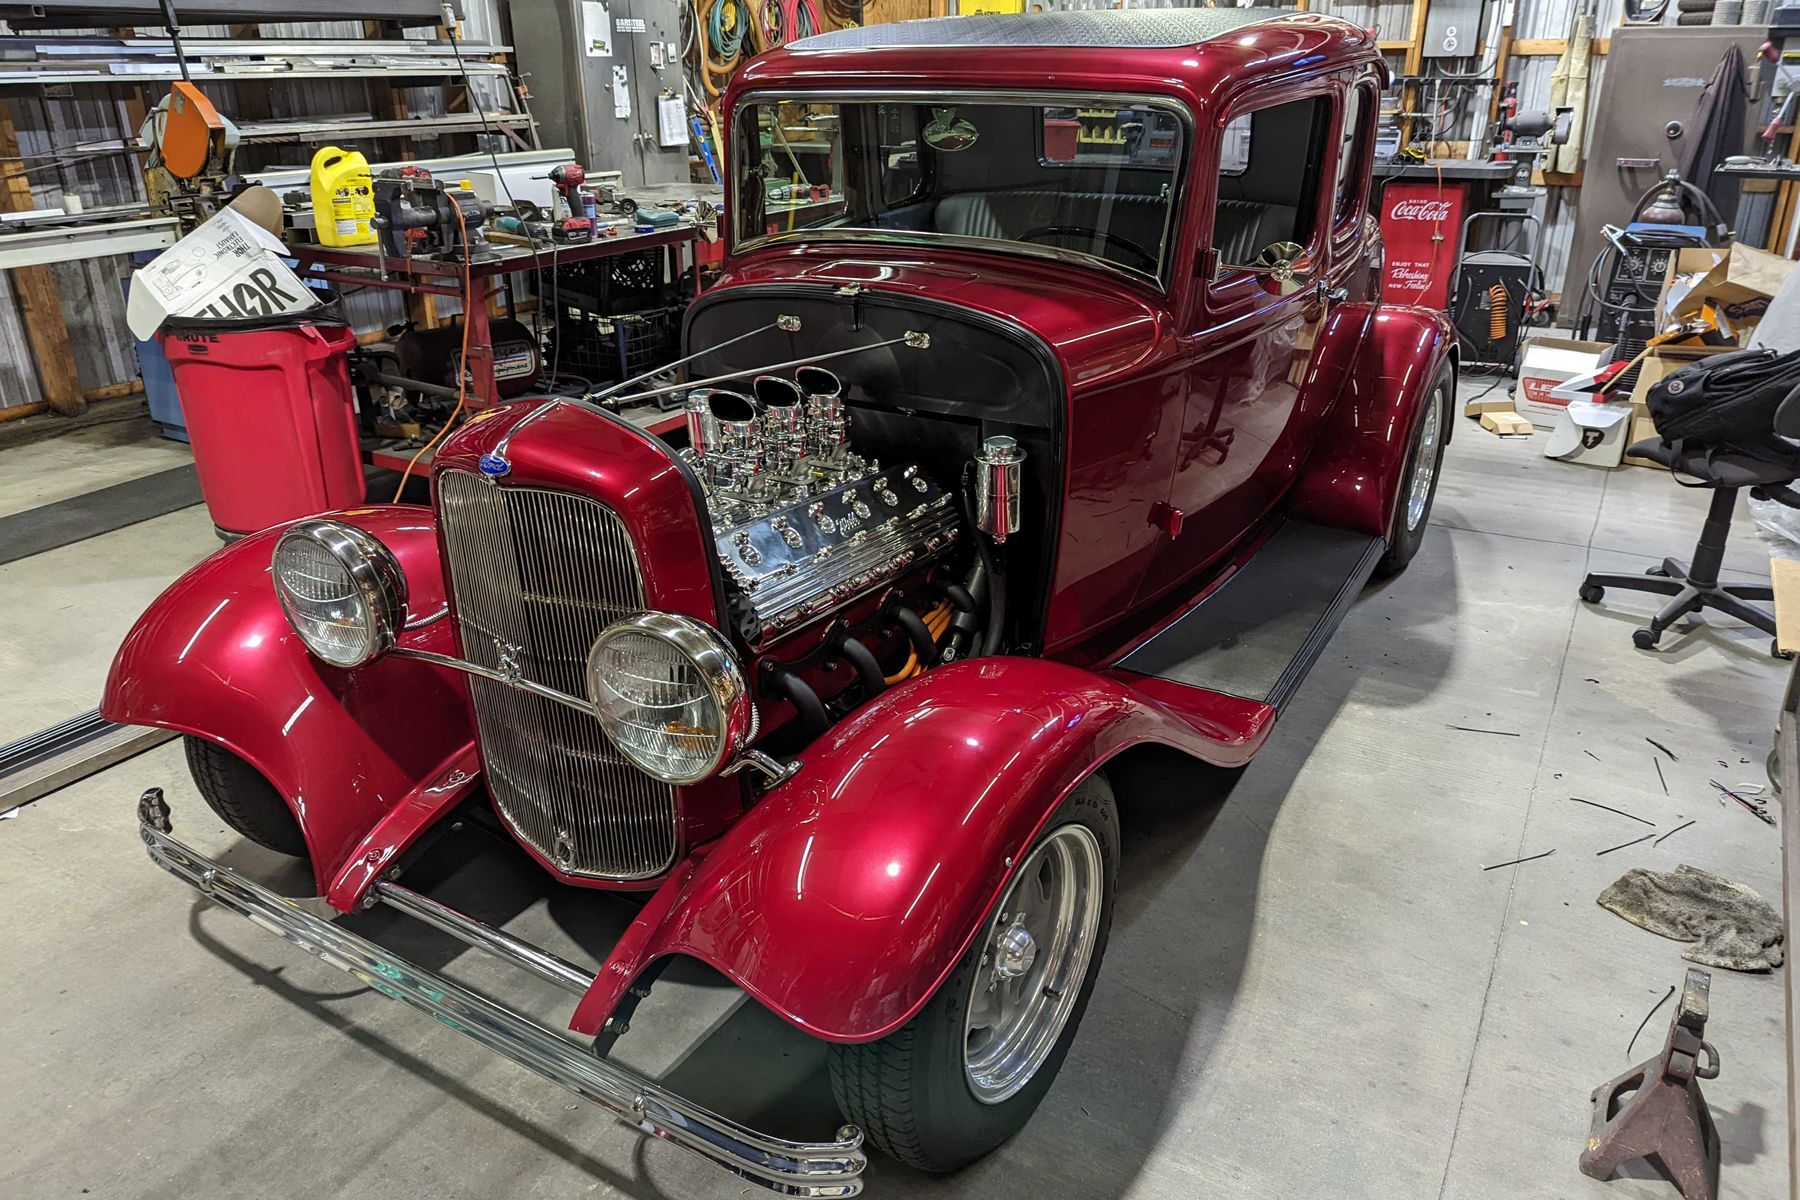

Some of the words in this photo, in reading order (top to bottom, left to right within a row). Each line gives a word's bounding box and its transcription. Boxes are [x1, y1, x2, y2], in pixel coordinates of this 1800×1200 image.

[1391, 201, 1453, 220] Coca-Cola
[214, 237, 244, 259] ELECTRONIC
[216, 231, 239, 249] EXHAUST
[232, 242, 251, 258] THOR
[1391, 268, 1429, 281] Refreshing
[481, 458, 506, 471] Ford
